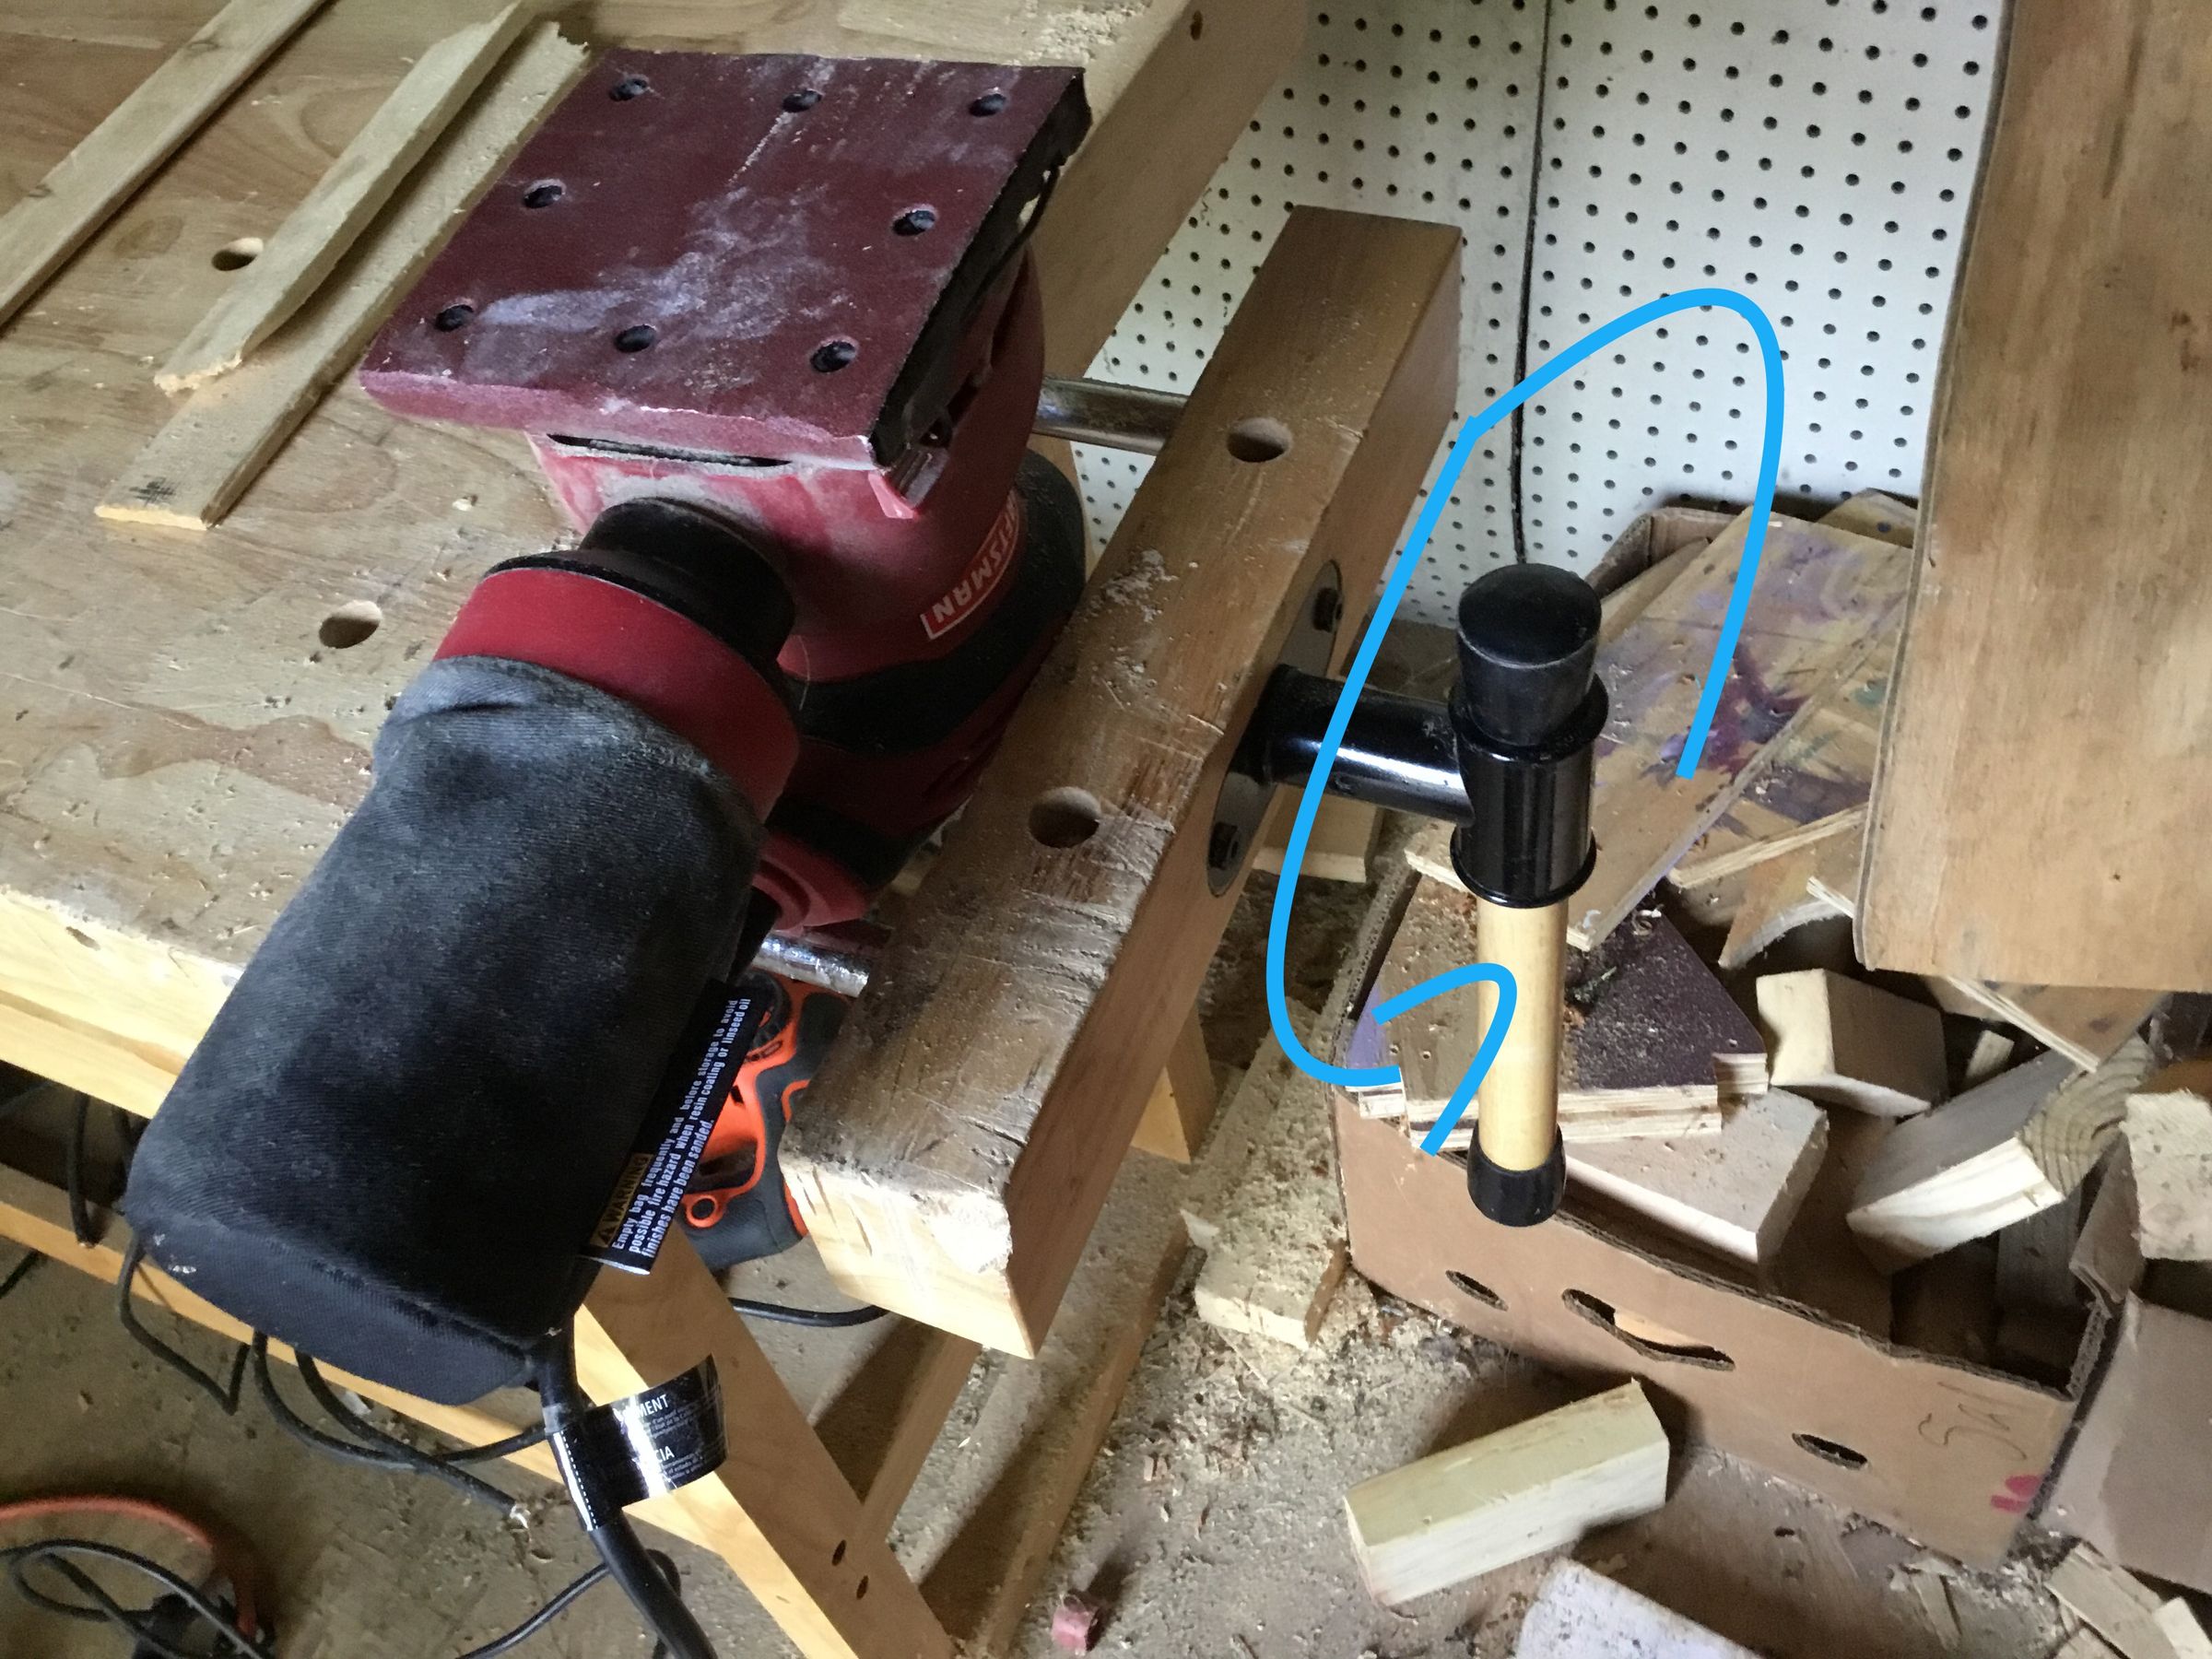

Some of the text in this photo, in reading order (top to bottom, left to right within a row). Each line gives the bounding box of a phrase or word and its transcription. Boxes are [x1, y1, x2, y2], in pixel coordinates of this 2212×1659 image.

[603, 1156, 648, 1222] WARNING
[612, 1000, 738, 1250] Empty bag frequently and before storage to avoid
[629, 998, 751, 1254] possible fire hazard when resin coating or linseed oil
[641, 1119, 714, 1258] finishes have been sanded.
